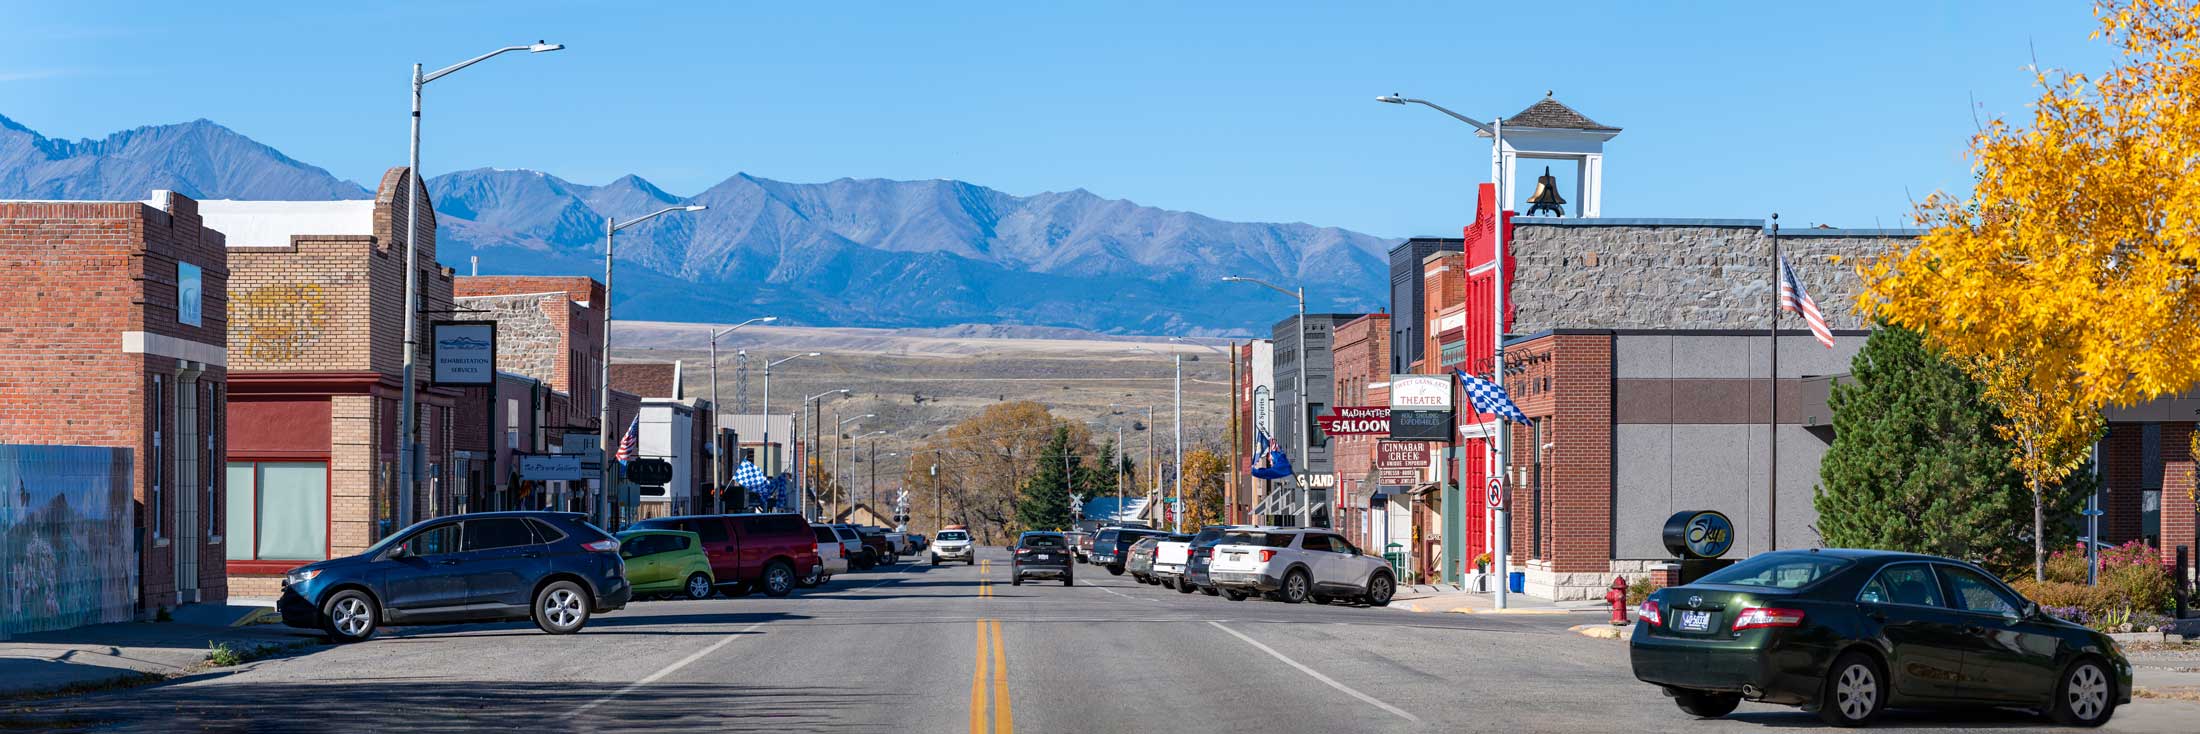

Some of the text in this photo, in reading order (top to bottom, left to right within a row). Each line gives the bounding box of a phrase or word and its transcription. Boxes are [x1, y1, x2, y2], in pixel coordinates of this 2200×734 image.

[1395, 379, 1413, 389] SWEET
[1434, 380, 1448, 390] ARTS
[1400, 396, 1442, 405] THEATER
[1258, 398, 1266, 420] Spirits
[1341, 408, 1390, 418] MADHATTER
[1331, 420, 1390, 432] SALOON
[1383, 443, 1424, 452] CINNABAR
[1389, 452, 1419, 461] CREEK
[1690, 517, 1721, 555] Sky
